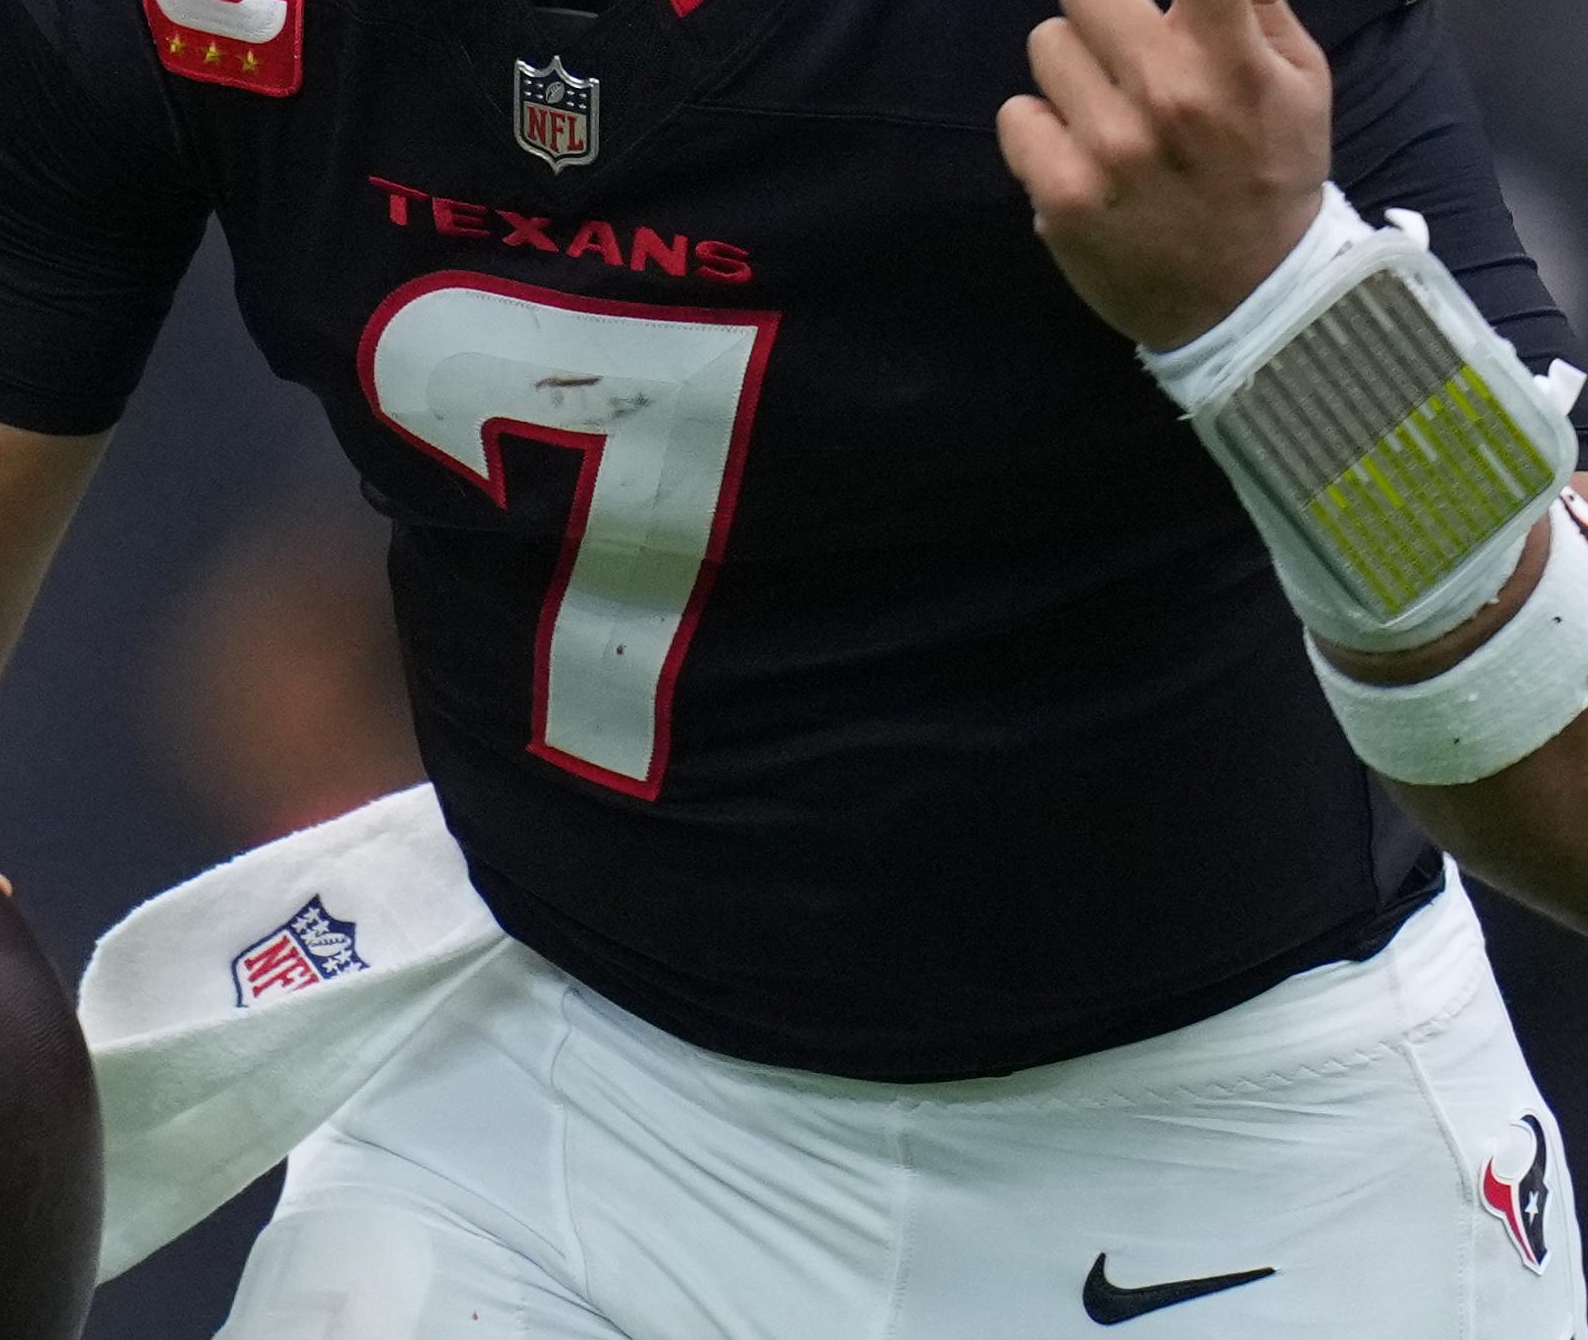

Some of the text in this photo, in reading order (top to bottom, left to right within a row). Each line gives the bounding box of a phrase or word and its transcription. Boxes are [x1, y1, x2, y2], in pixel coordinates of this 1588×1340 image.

[526, 105, 584, 153] NFL
[368, 175, 752, 284] TEXANS
[357, 269, 781, 800] 7
